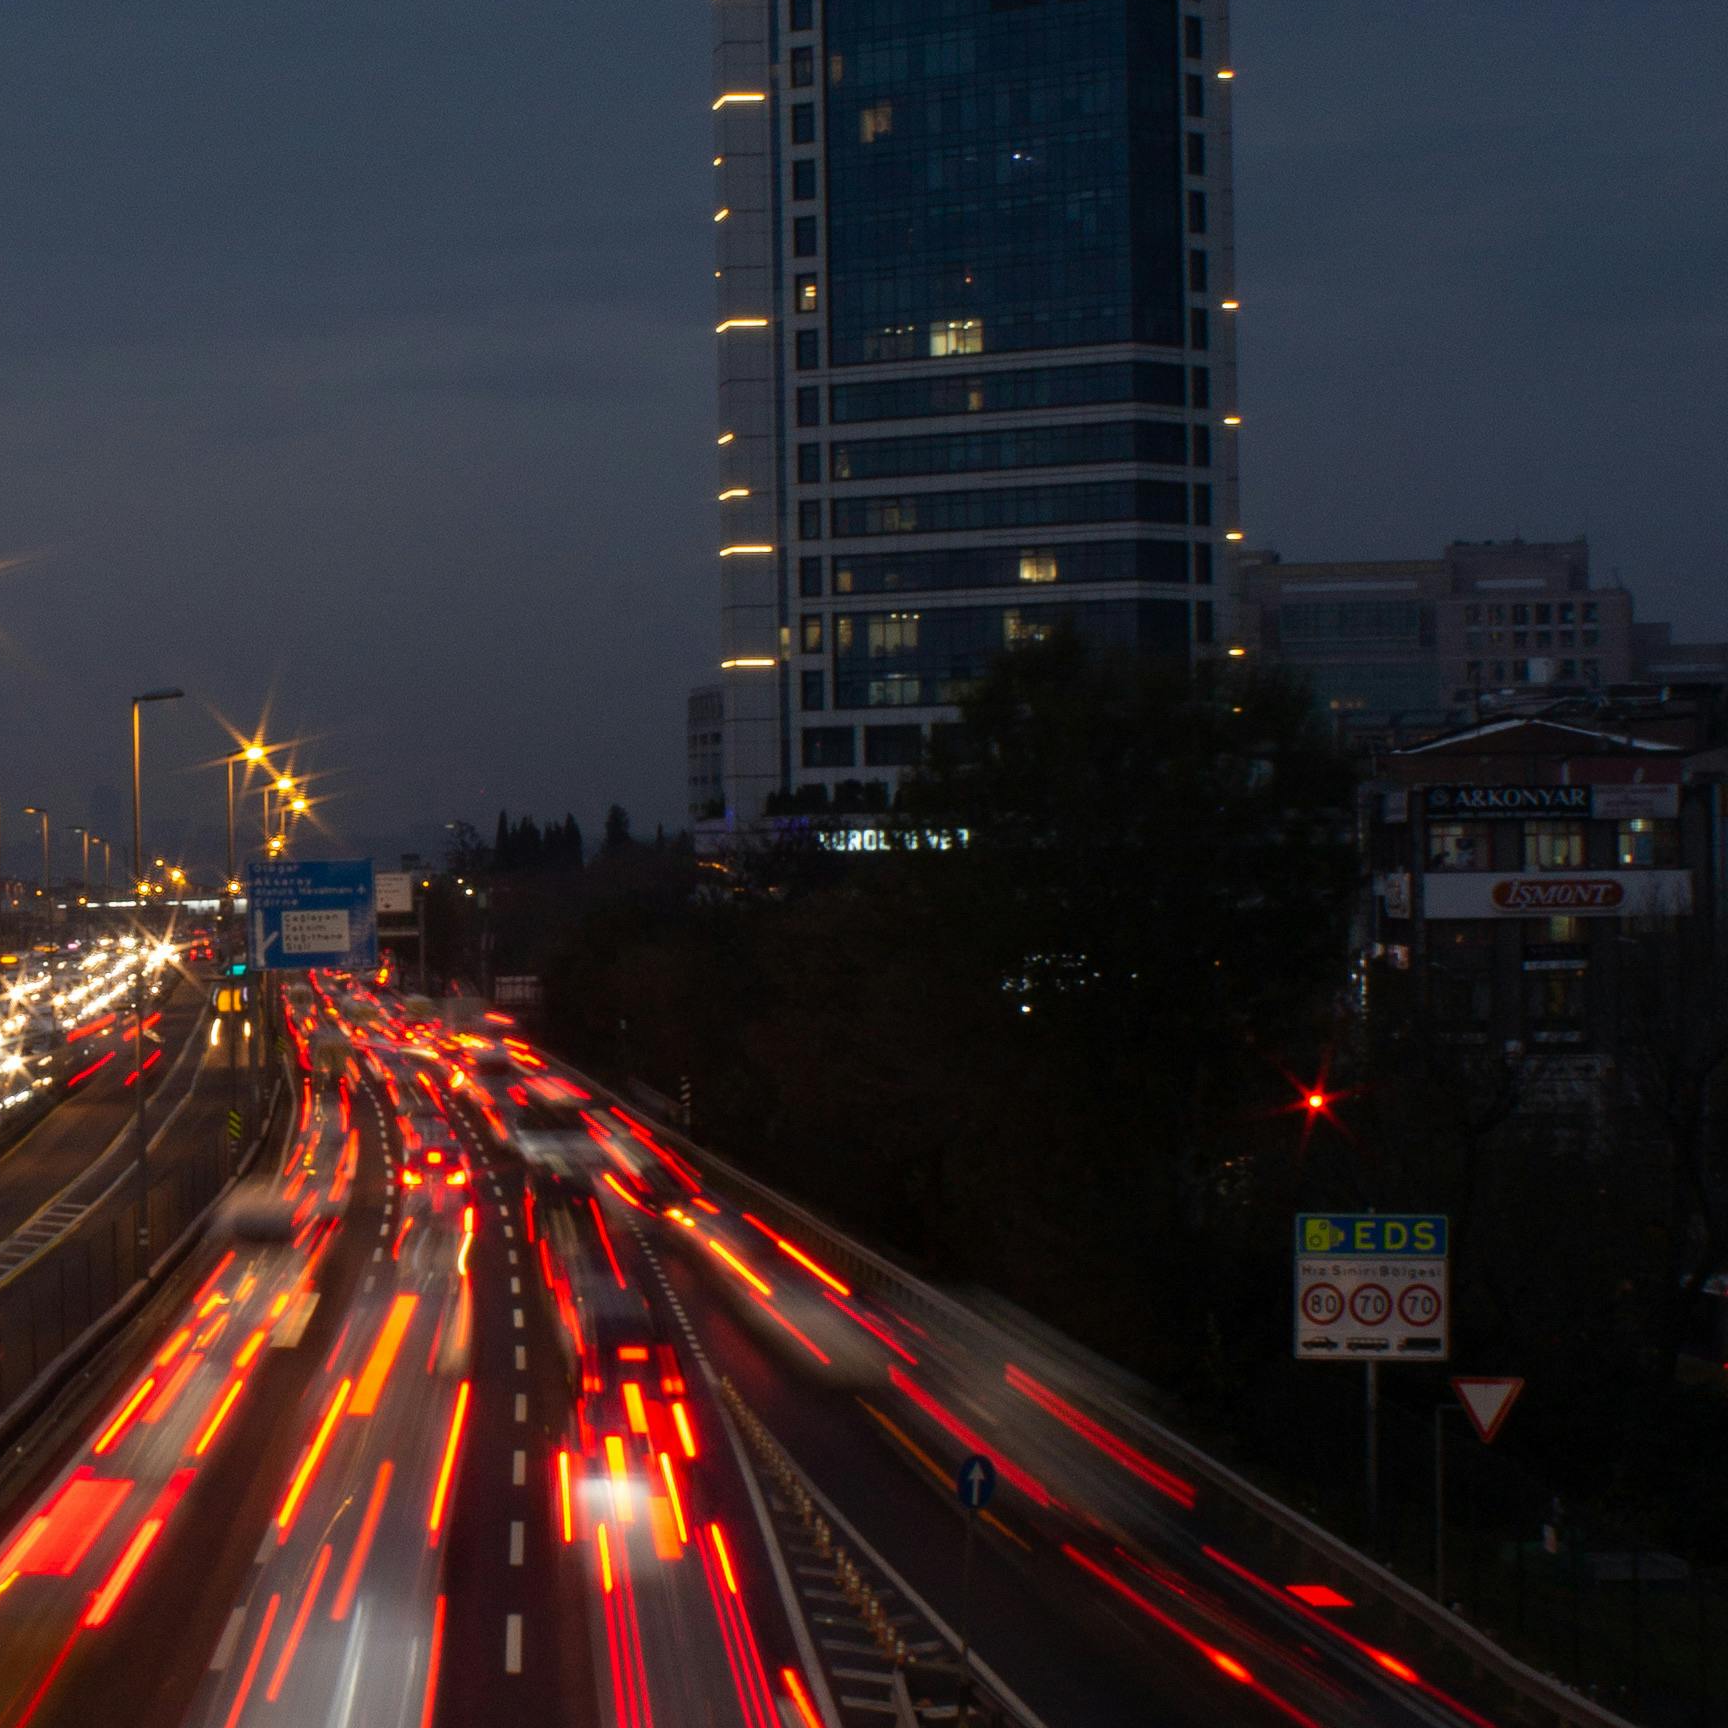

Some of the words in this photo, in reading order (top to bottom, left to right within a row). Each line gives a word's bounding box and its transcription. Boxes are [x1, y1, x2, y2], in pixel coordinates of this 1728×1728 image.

[1354, 1220, 1437, 1251] EDS
[1311, 1294, 1337, 1313] 80
[1359, 1295, 1385, 1314] 70
[1407, 1295, 1433, 1315] 70
